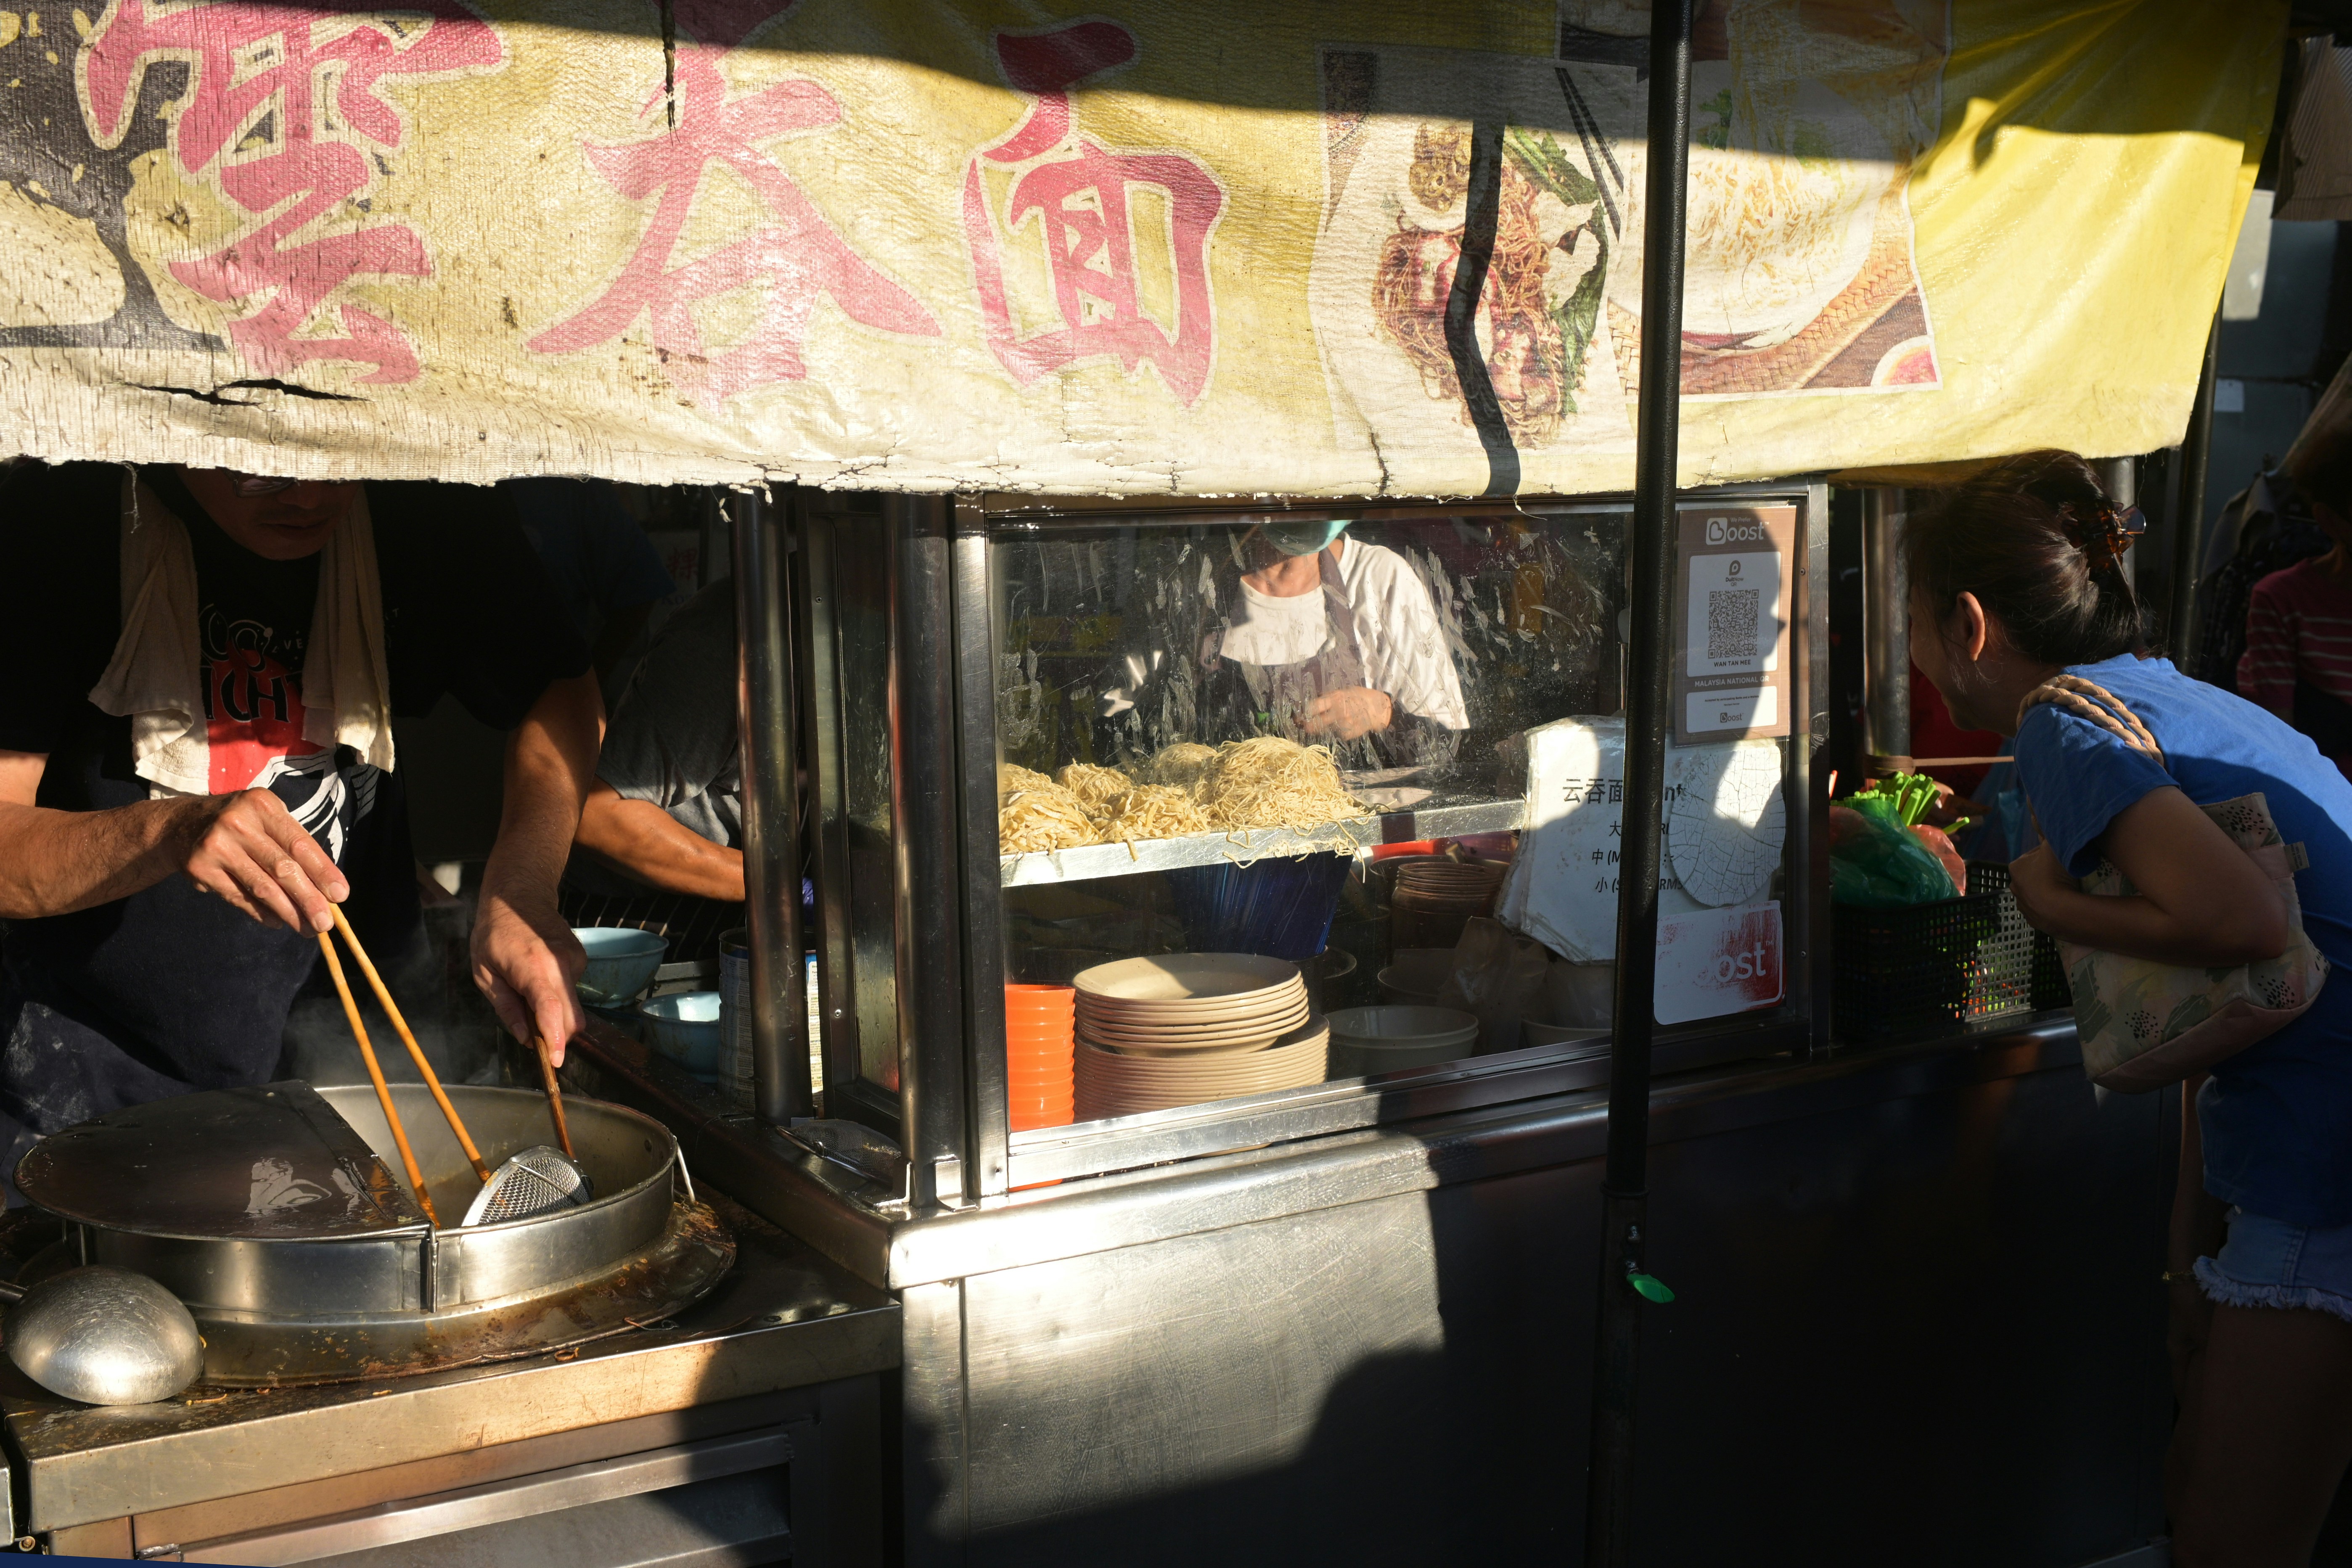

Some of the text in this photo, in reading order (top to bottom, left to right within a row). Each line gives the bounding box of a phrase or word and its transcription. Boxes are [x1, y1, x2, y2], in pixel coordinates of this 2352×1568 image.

[1695, 679, 1725, 687] MALAYSIA
[1727, 677, 1758, 685] NATIONAL
[1720, 712, 1742, 723] Boost
[1562, 778, 1622, 804] 云吞面
[1609, 820, 1621, 837] 大
[1592, 848, 1603, 865] 中
[1595, 877, 1608, 893] 小
